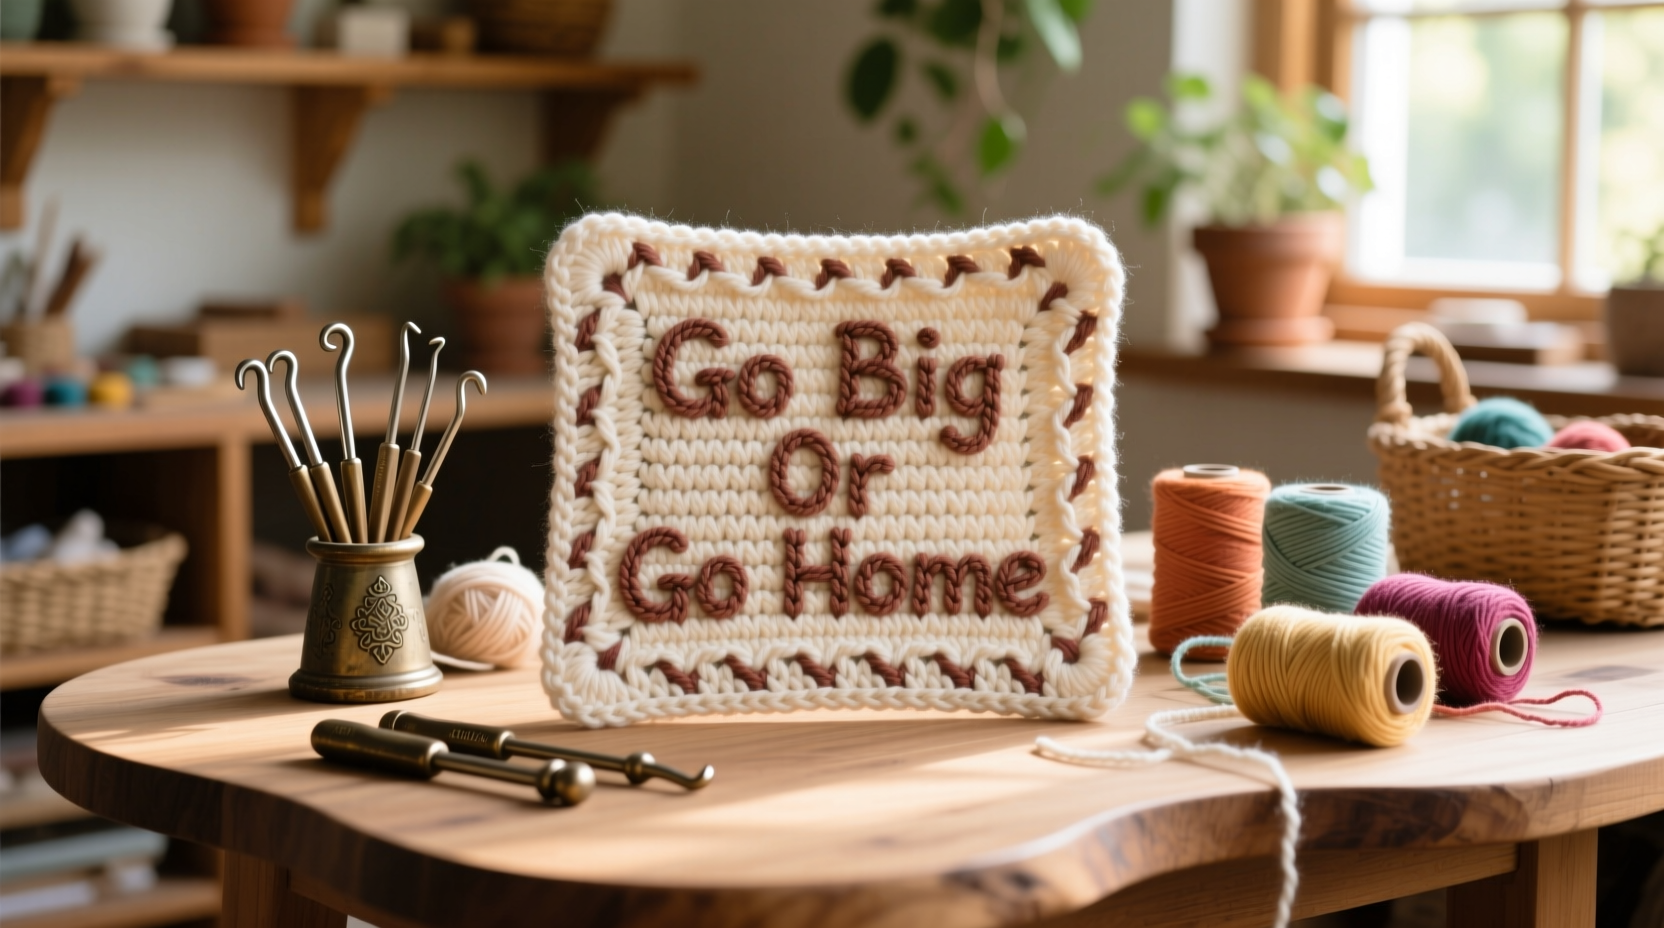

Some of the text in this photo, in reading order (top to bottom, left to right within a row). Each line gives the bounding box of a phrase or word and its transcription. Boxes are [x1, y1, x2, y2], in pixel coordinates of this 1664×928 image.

[653, 318, 1005, 454] Go Big
[770, 428, 895, 517] Or
[619, 526, 1049, 623] Go Home
